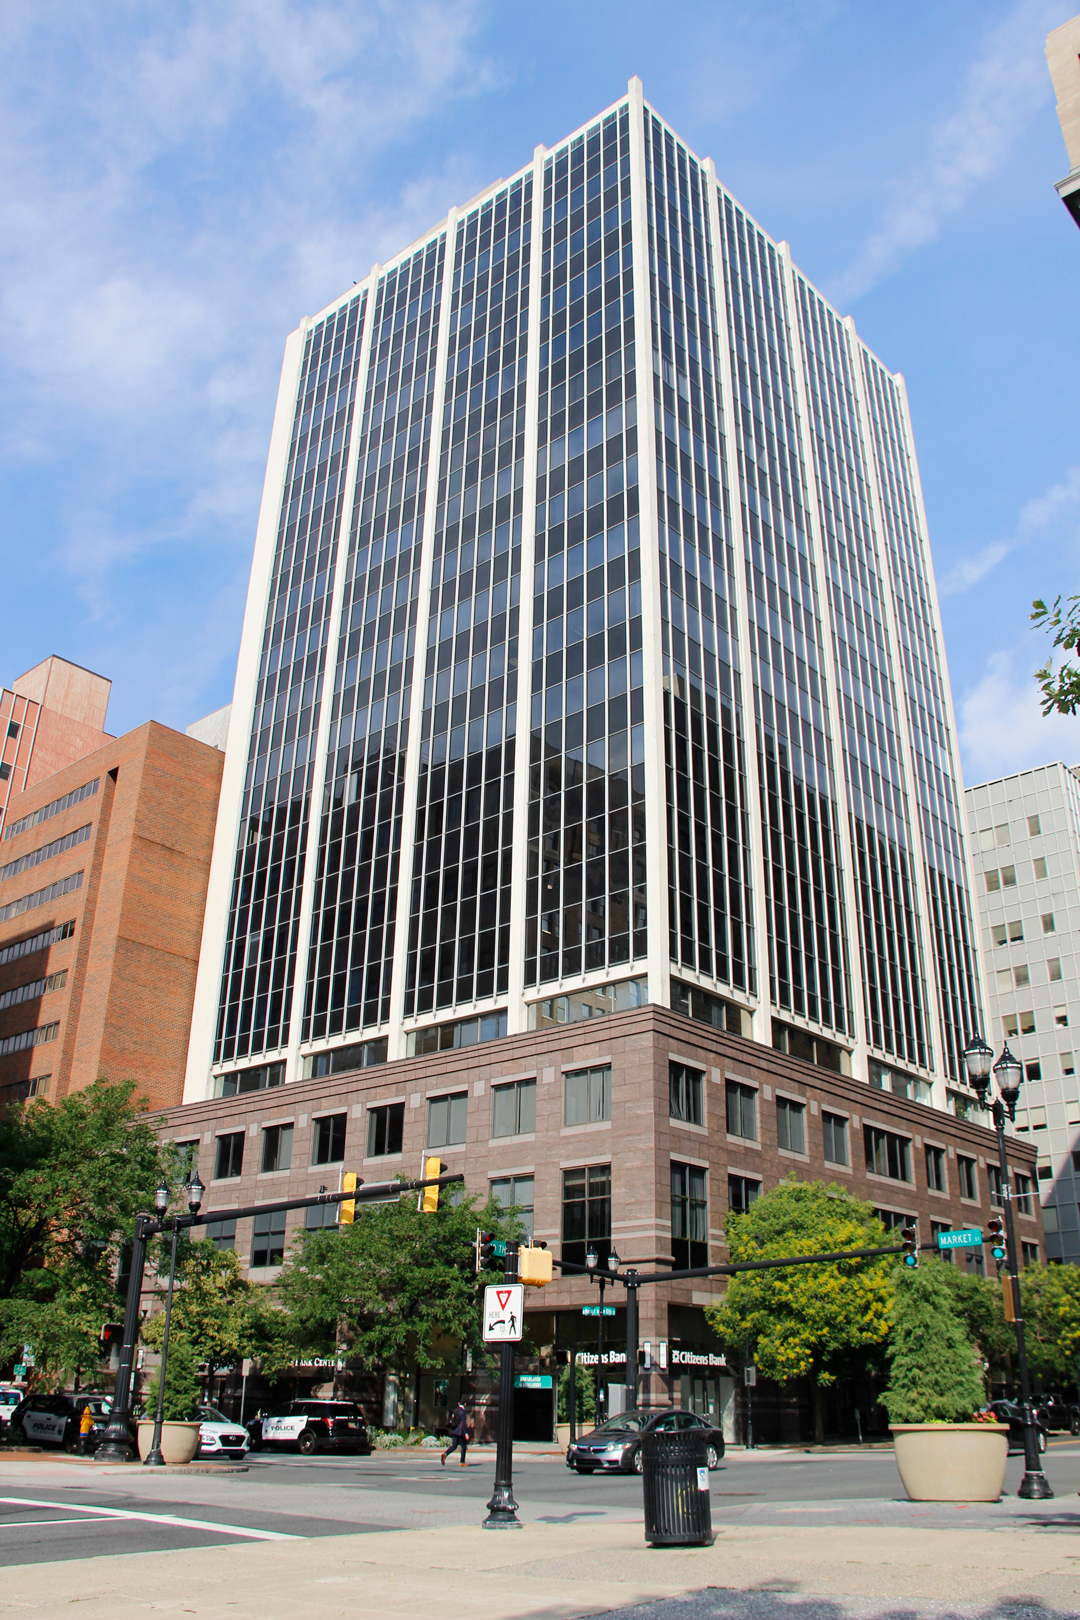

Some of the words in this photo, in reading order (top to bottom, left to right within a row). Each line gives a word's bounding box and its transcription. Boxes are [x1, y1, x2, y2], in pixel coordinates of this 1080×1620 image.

[940, 1233, 972, 1246] MARKET
[488, 1311, 501, 1319] HERE
[499, 1325, 506, 1333] TO
[313, 1357, 337, 1368] CENTE
[609, 1350, 627, 1364] Ban
[680, 1351, 709, 1366] Citizens
[708, 1352, 727, 1367] Bank
[33, 1422, 57, 1431] POLICE
